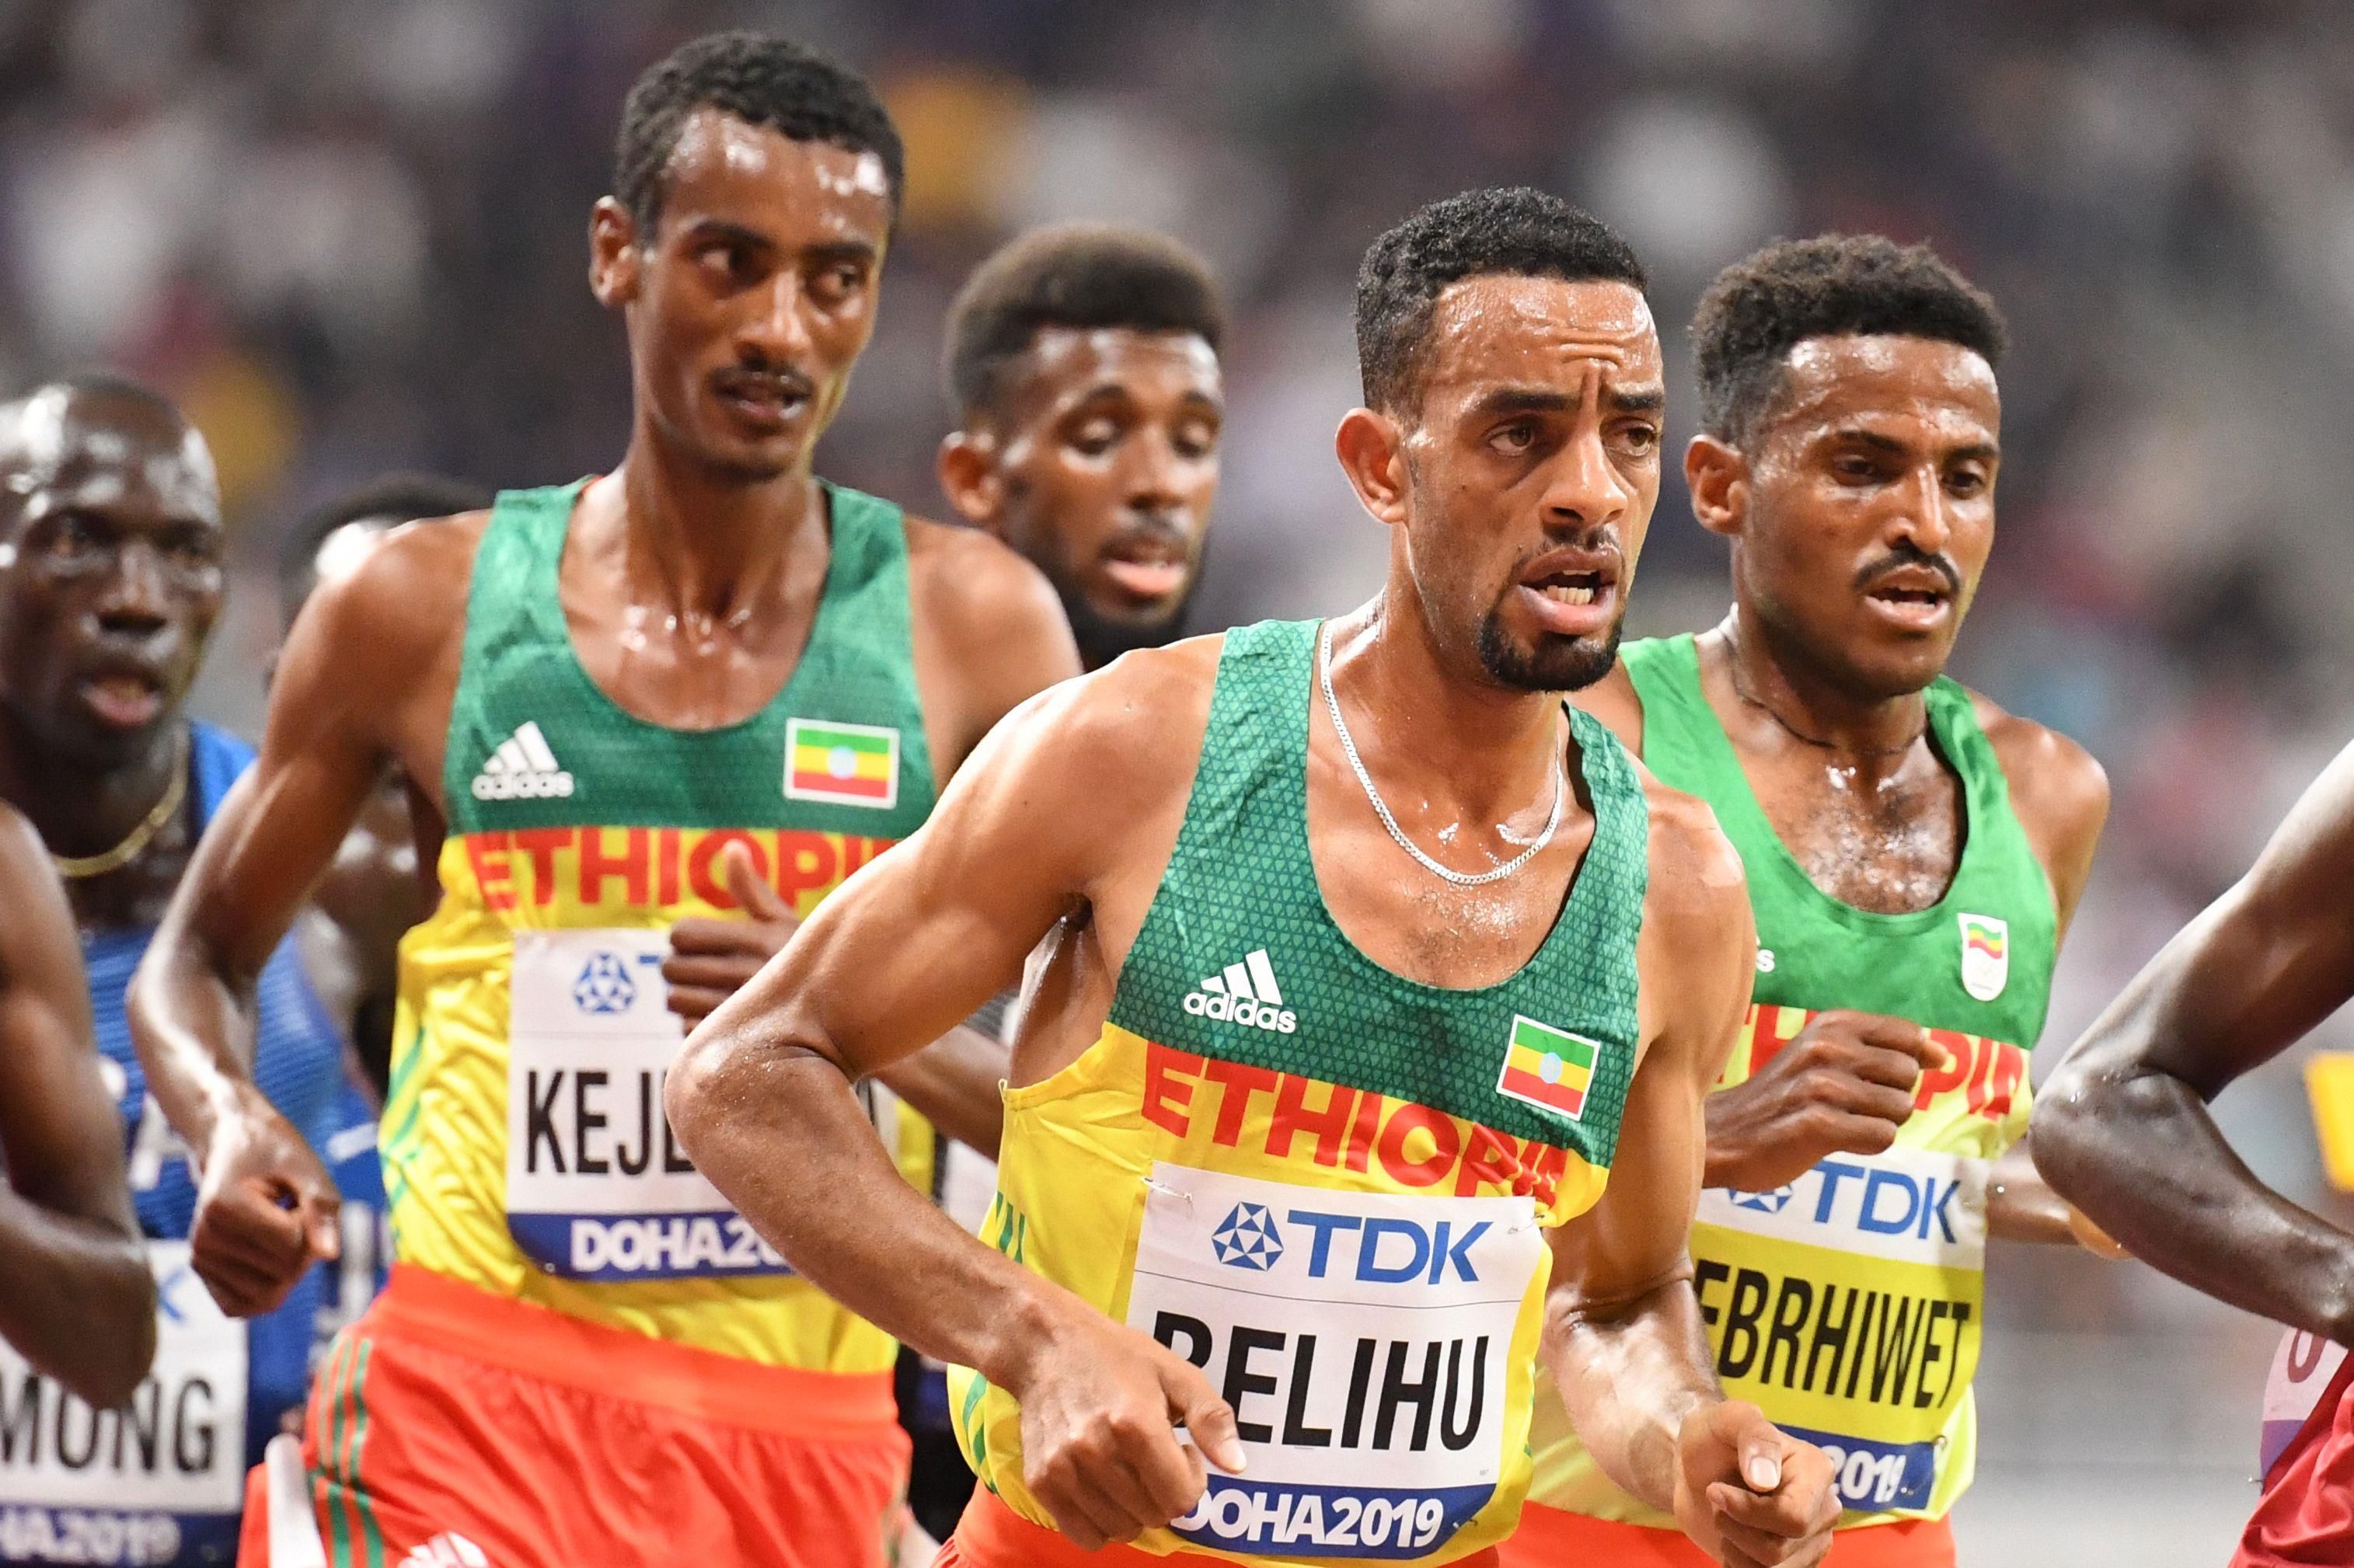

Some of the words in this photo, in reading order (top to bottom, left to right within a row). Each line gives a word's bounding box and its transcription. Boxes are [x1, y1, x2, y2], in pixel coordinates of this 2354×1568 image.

[465, 825, 898, 911] ETHIOPI
[1184, 991, 1296, 1034] adidas
[1141, 1040, 1569, 1211] ETHIOPIA
[1809, 1159, 1962, 1244] TDK
[1287, 1211, 1494, 1286] TDK
